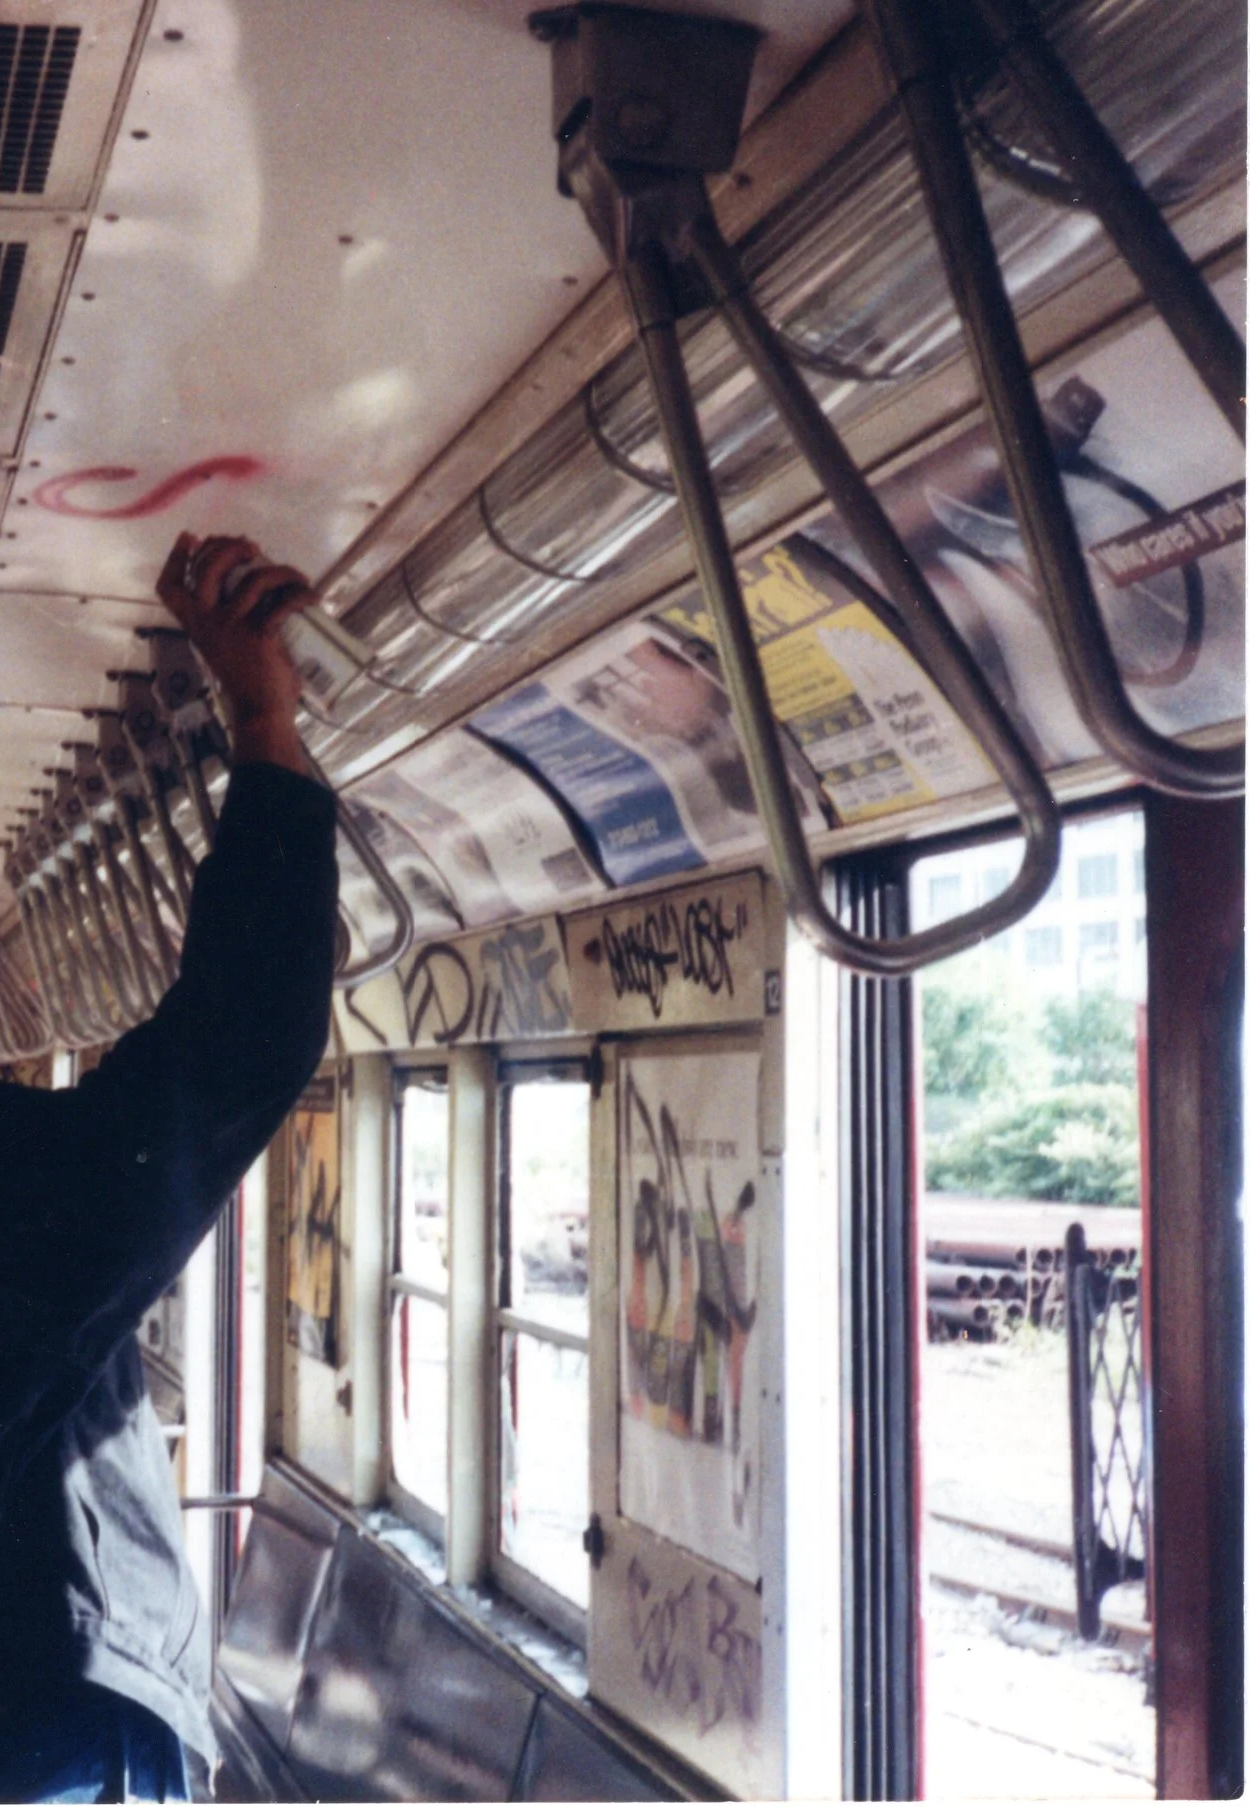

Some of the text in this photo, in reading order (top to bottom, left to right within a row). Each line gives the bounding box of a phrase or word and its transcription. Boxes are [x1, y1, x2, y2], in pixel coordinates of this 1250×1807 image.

[1096, 541, 1148, 575] Who
[1139, 521, 1196, 563] cares
[1182, 508, 1212, 541] if
